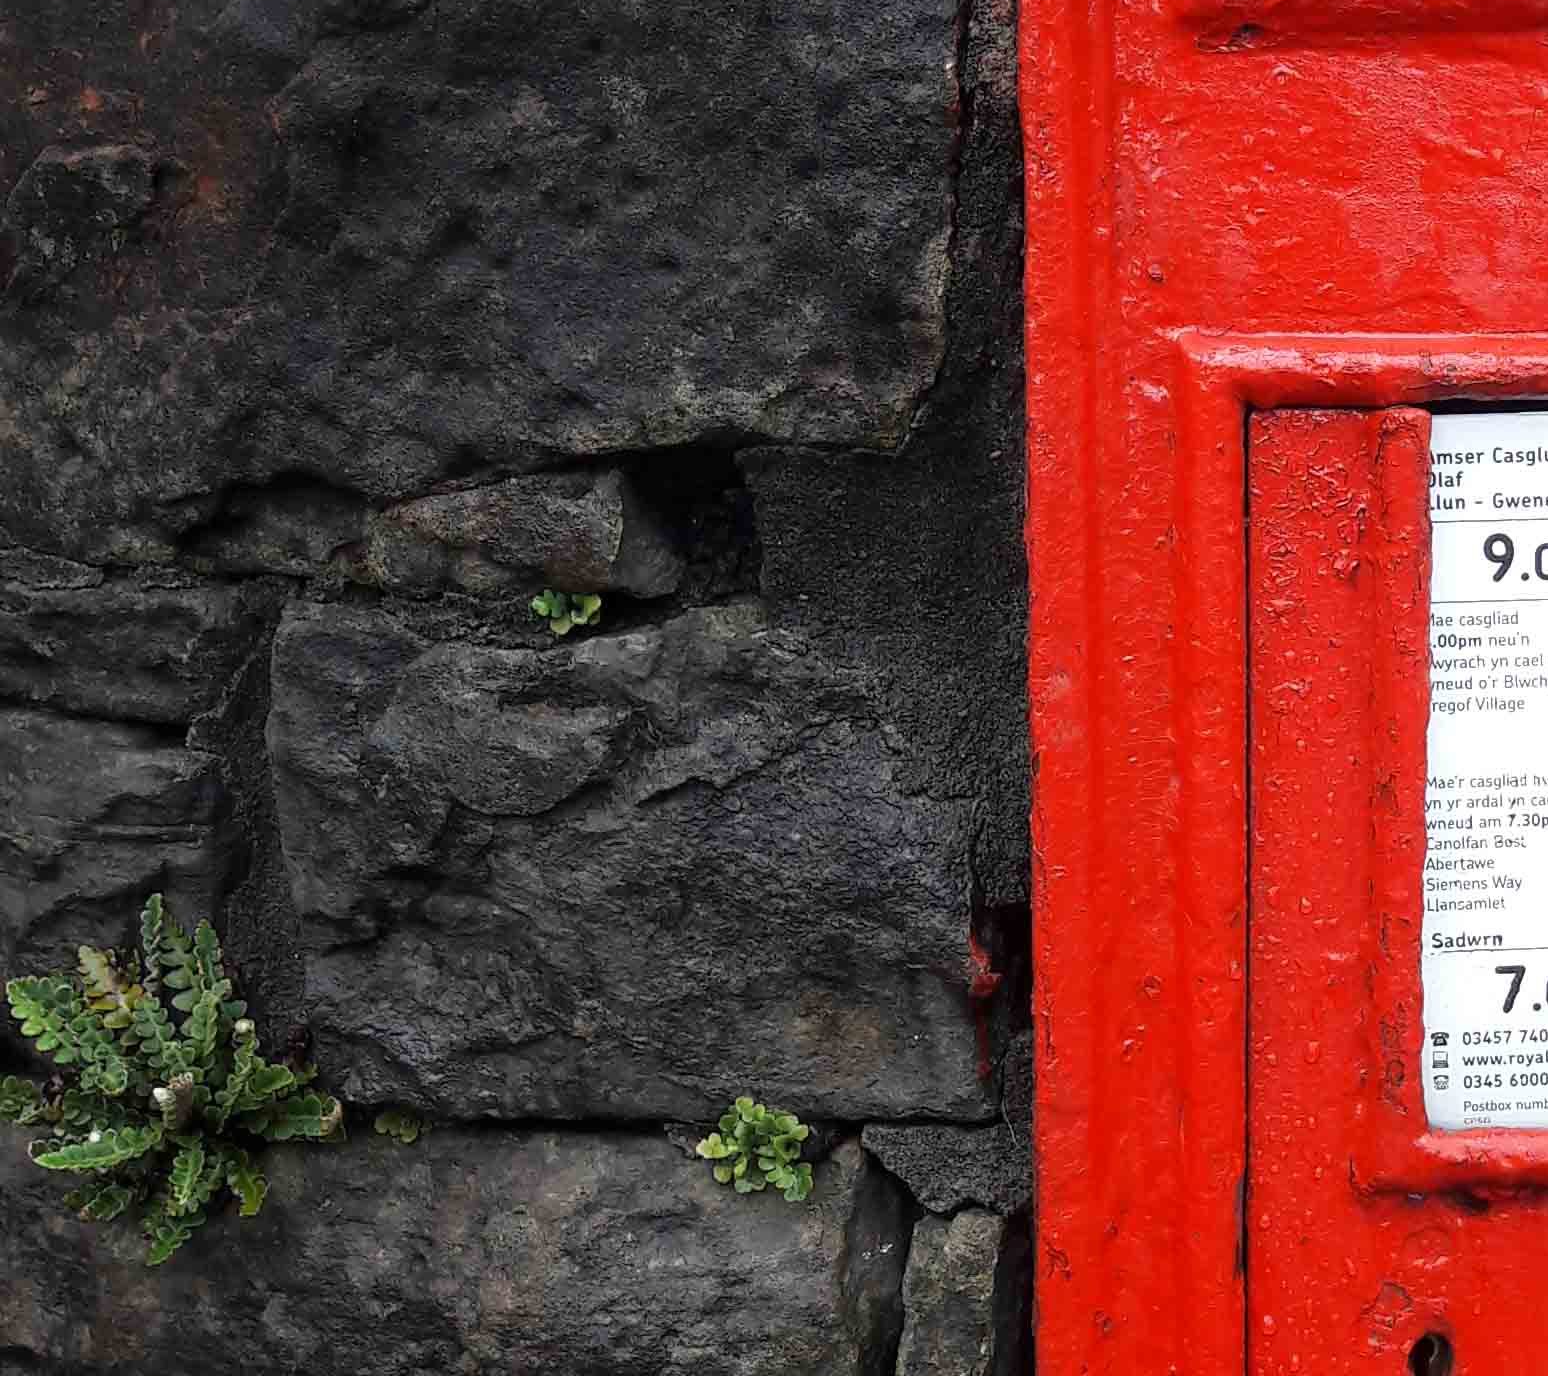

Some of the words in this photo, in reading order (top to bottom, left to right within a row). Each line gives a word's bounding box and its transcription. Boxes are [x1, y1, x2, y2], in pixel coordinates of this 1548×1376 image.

[1459, 609, 1519, 629] casgliad
[1432, 633, 1482, 650] .00pm
[1488, 631, 1530, 647] neu'n
[1431, 654, 1485, 672] wyrach
[1491, 656, 1509, 671] yn
[1514, 653, 1544, 667] cael
[1478, 674, 1499, 689] o'r
[1431, 697, 1472, 715] regof
[1475, 697, 1526, 712] Village
[1425, 775, 1465, 789] Mae'r
[1469, 773, 1528, 790] casgliad
[1425, 799, 1442, 812] yn
[1447, 799, 1462, 812] yr
[1466, 794, 1503, 808] ardal
[1509, 797, 1525, 809] yn
[1425, 815, 1473, 830] wneud
[1479, 818, 1501, 829] am
[1427, 835, 1488, 850] Canolfan
[1426, 856, 1496, 872] Abertawe
[1426, 877, 1488, 891] Siemens
[1492, 874, 1522, 891] Way
[1426, 897, 1506, 913] Llansamlet
[1431, 931, 1503, 949] Sadwrn
[1462, 1031, 1512, 1046] 03457
[1463, 1074, 1503, 1089] 0345
[1463, 1097, 1512, 1113] Postbox
